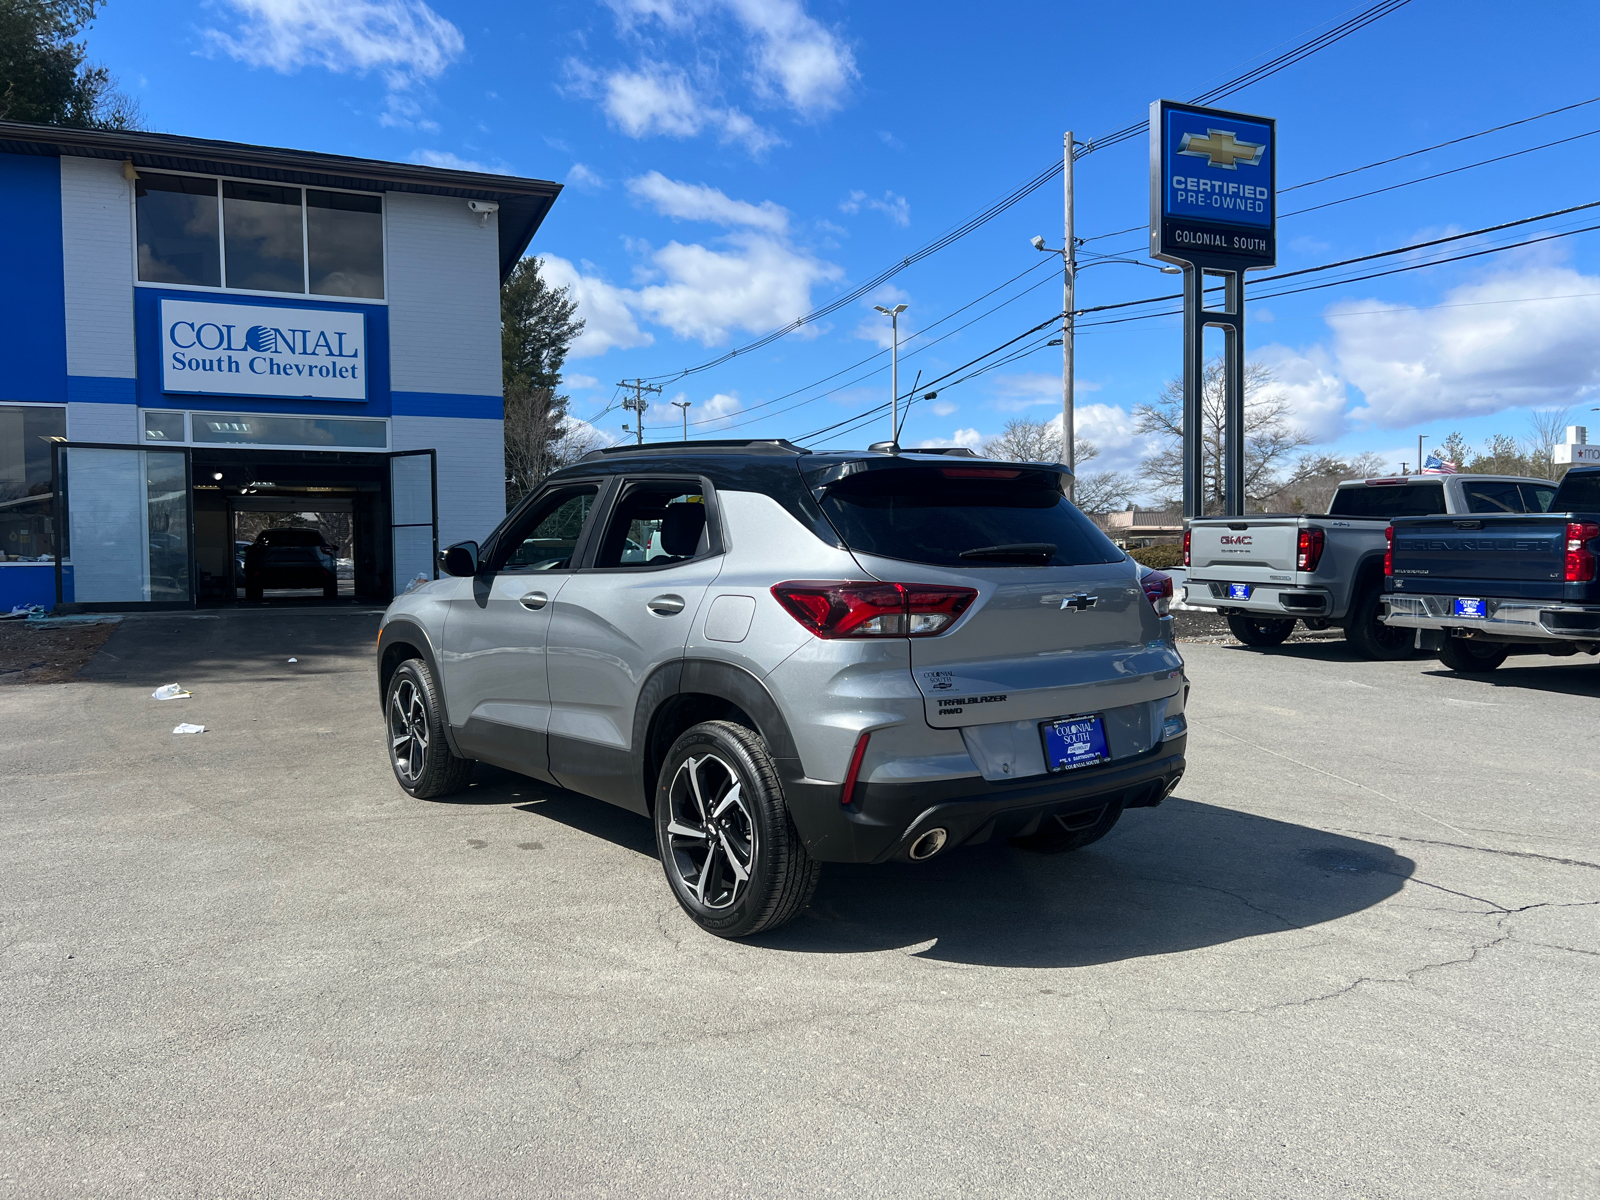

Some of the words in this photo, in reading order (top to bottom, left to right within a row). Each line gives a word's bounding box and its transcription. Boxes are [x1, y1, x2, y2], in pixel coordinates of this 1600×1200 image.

[1172, 175, 1268, 199] CERTIFIED
[1177, 191, 1264, 213] PRE-OWNED
[1175, 229, 1227, 247] COLONIAL
[1233, 236, 1266, 251] SOUTH
[169, 321, 359, 359] COLONIAL
[172, 351, 241, 374] South
[249, 356, 359, 380] Chevrolet
[1220, 535, 1253, 545] GMC
[1399, 540, 1549, 551] CHEVROLET
[923, 671, 956, 679] COLONIAL
[937, 694, 1007, 707] TRAILBLAZER
[938, 707, 963, 716] AWD
[1056, 722, 1094, 737] COLONIAL
[1063, 732, 1091, 745] SOUTH
[1065, 761, 1086, 770] COLONIAL
